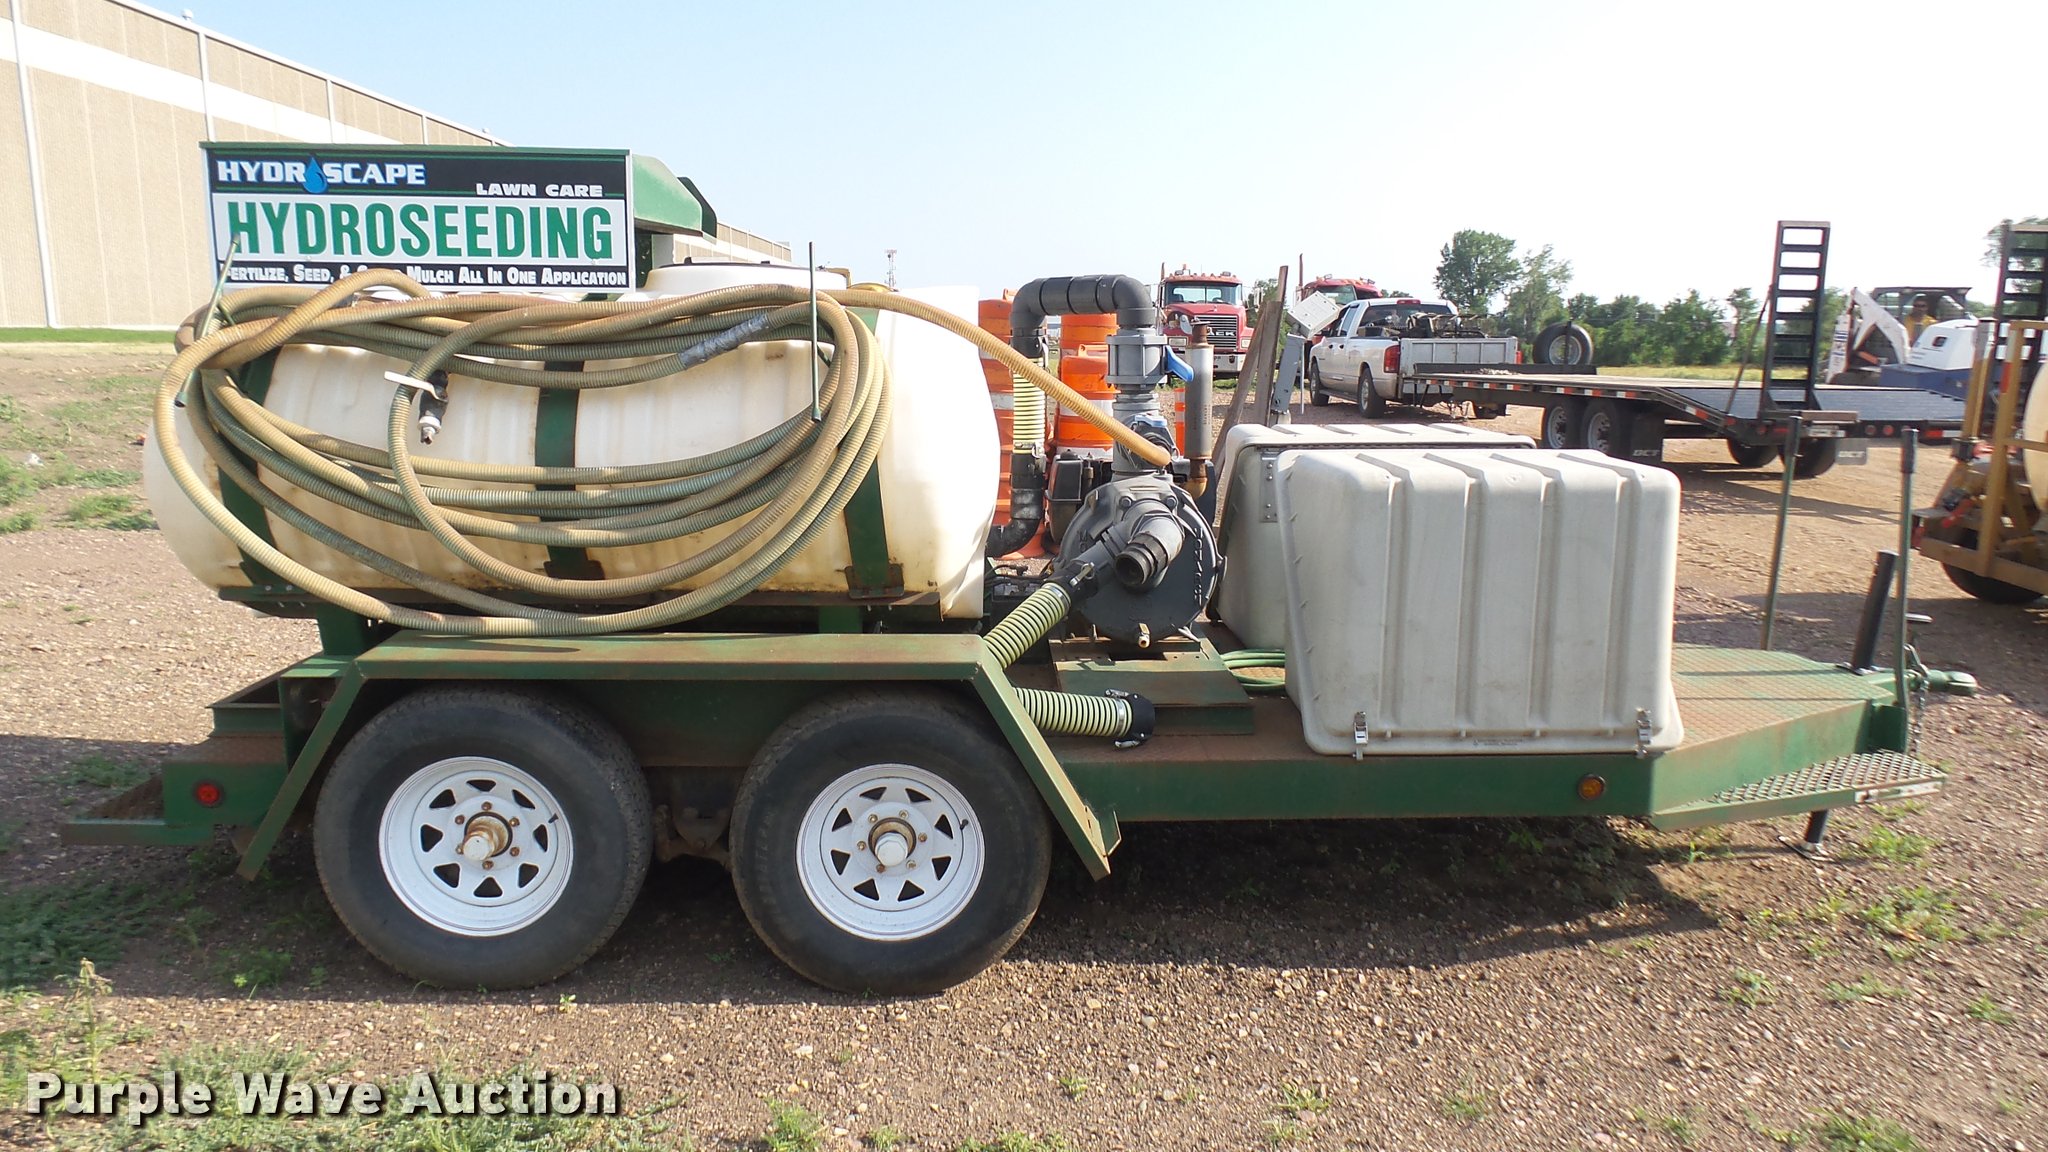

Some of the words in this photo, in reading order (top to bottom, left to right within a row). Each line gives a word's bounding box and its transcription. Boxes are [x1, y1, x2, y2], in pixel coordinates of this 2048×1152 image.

[476, 183, 537, 196] LAWN
[545, 184, 603, 197] CARE
[227, 201, 612, 260] HYDROSEEDING
